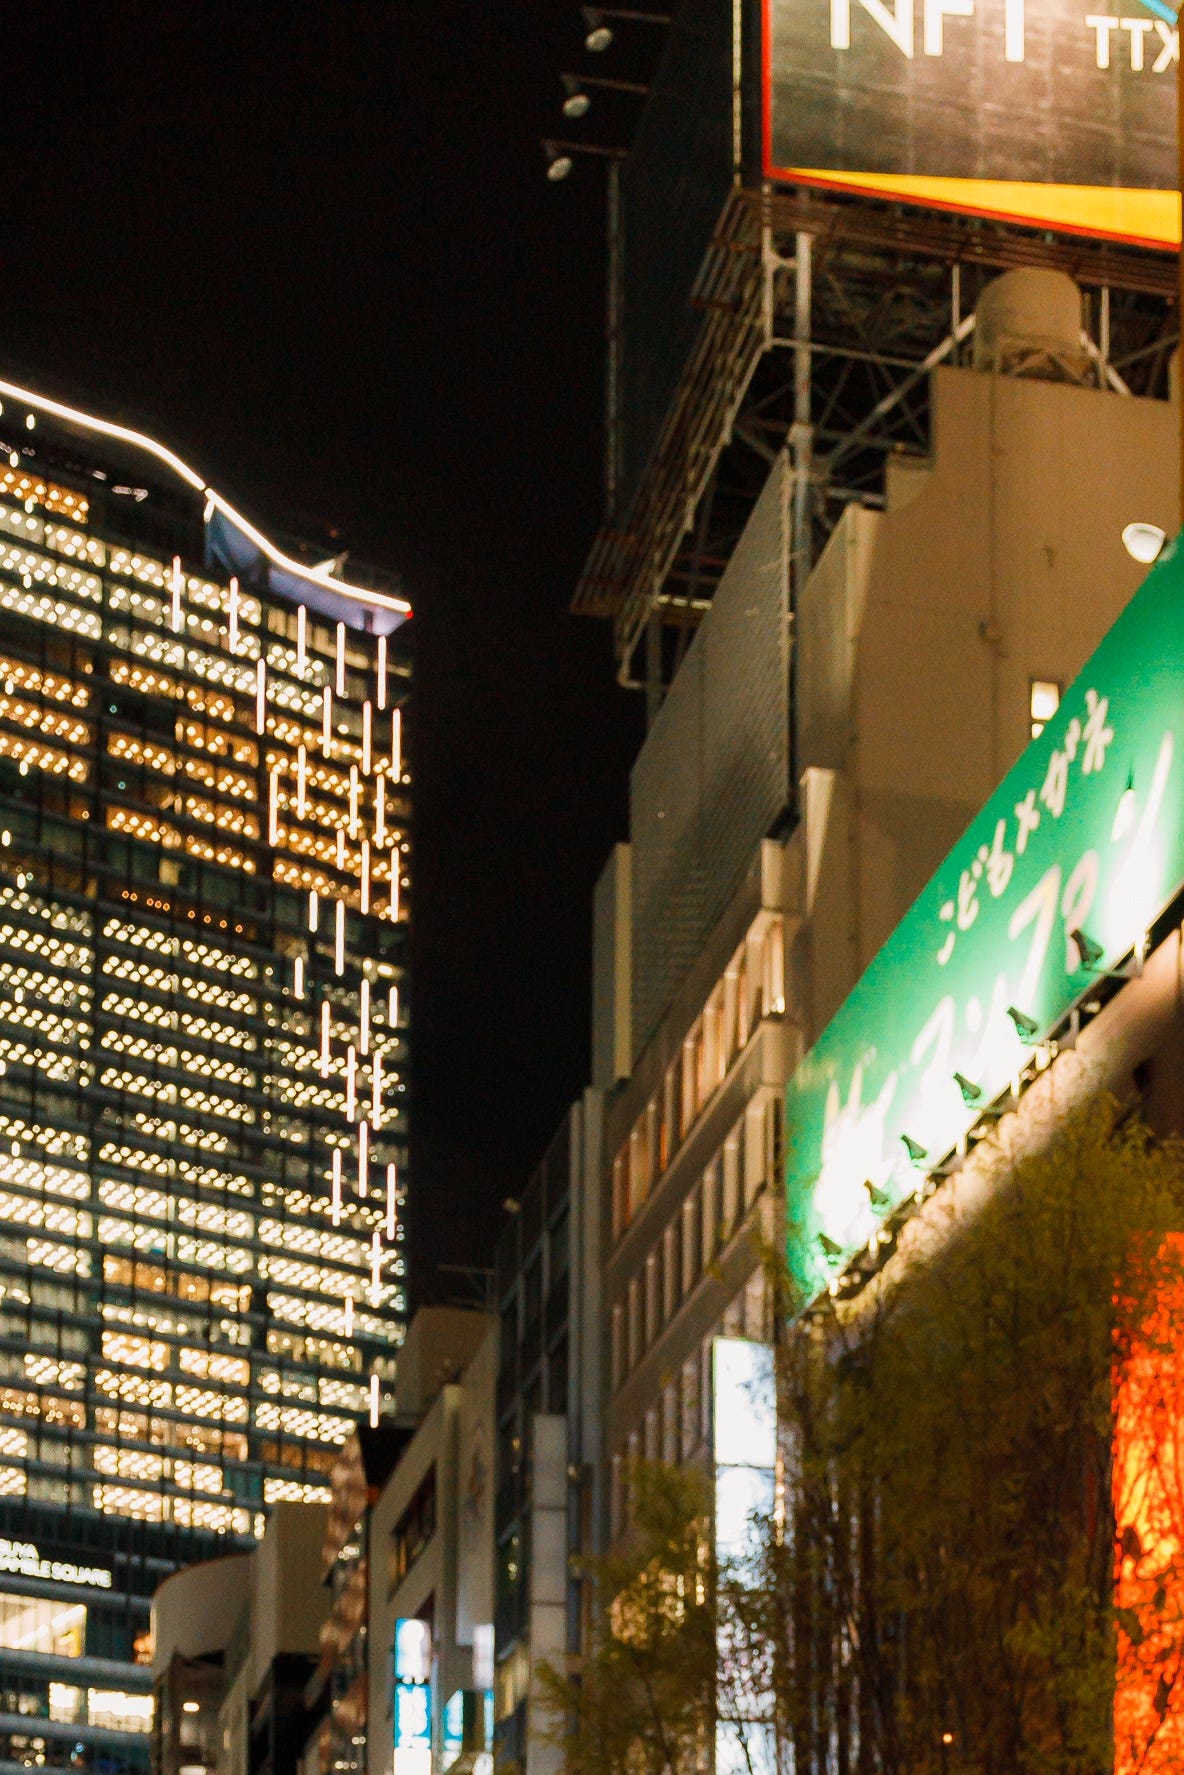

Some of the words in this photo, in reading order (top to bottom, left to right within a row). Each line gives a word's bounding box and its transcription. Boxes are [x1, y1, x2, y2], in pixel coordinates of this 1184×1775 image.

[936, 687, 1114, 967] こどもメガネ
